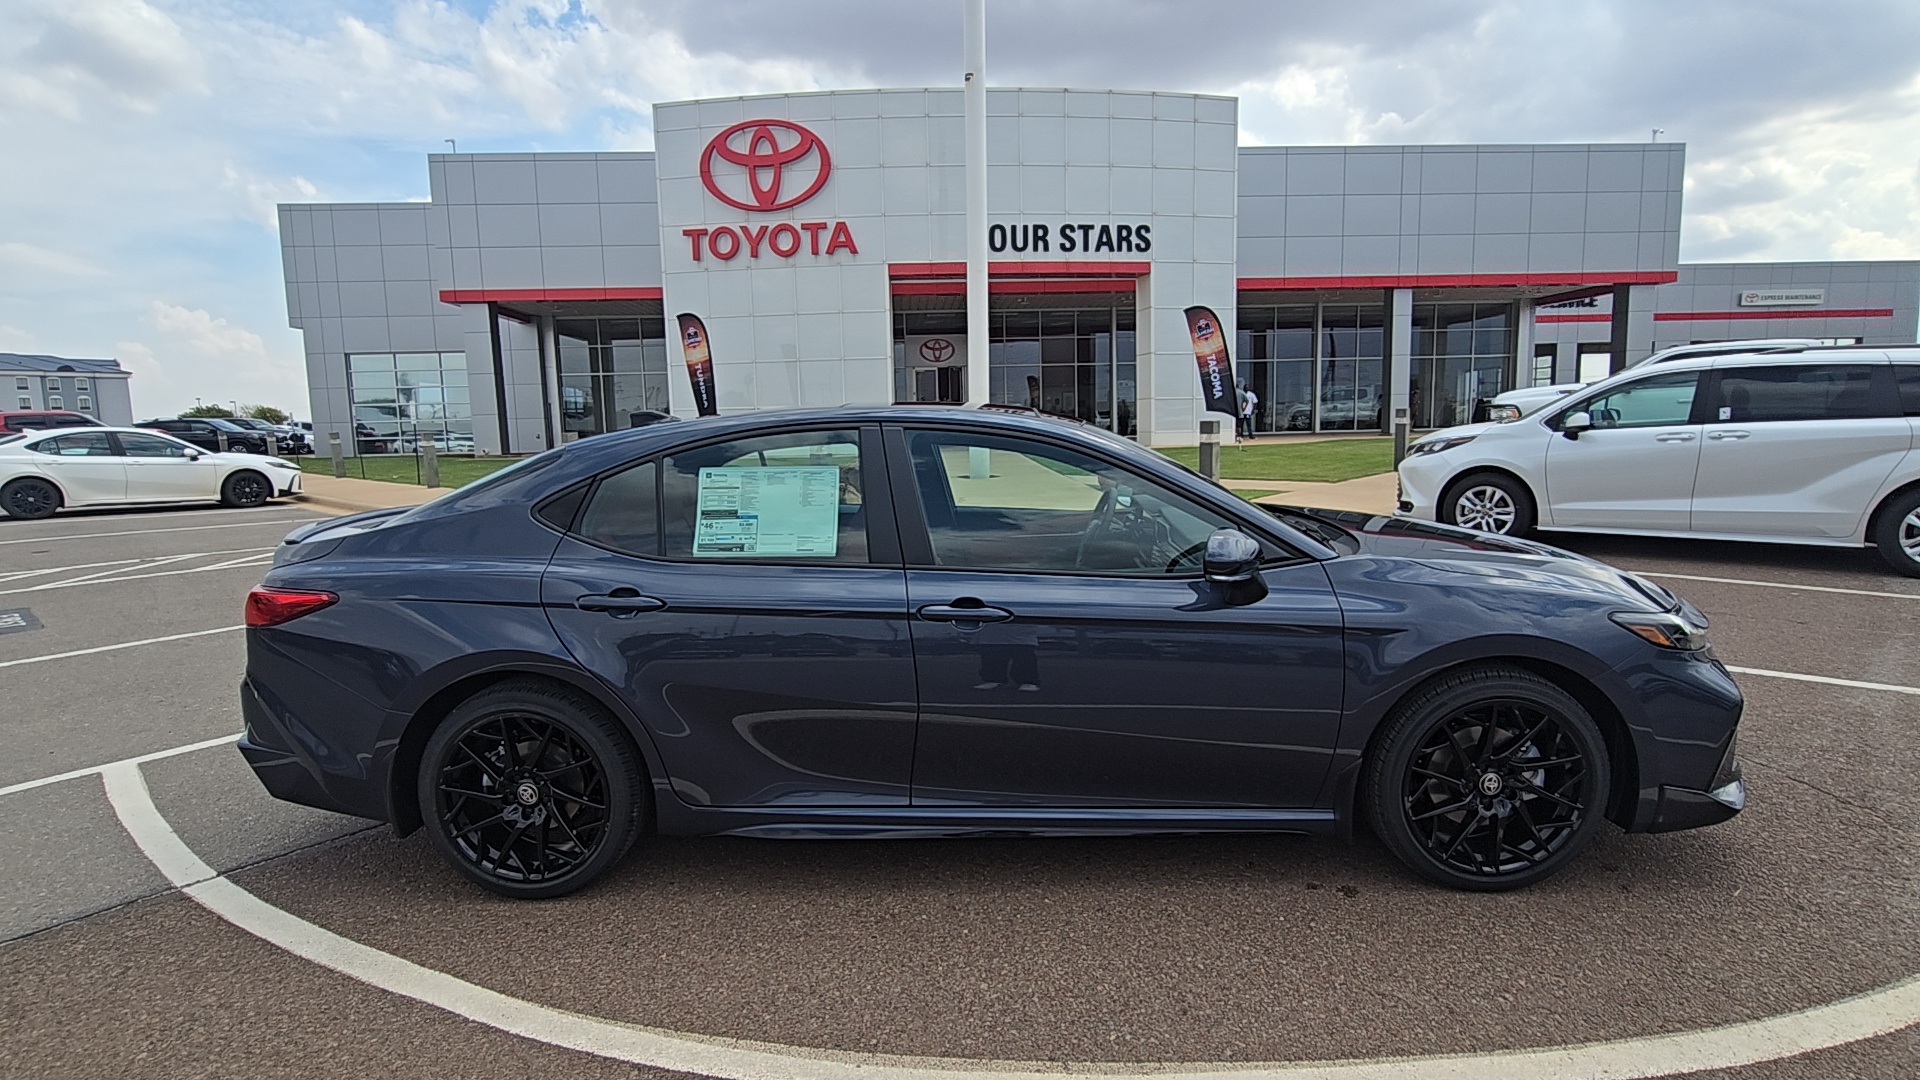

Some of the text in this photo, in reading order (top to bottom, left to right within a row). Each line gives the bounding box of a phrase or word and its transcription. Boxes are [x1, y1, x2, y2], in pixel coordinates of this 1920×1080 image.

[682, 221, 859, 261] TOYOTA
[988, 224, 1152, 252] OUR STARS
[694, 362, 709, 409] TUNDRA
[1206, 353, 1224, 400] TACOMA
